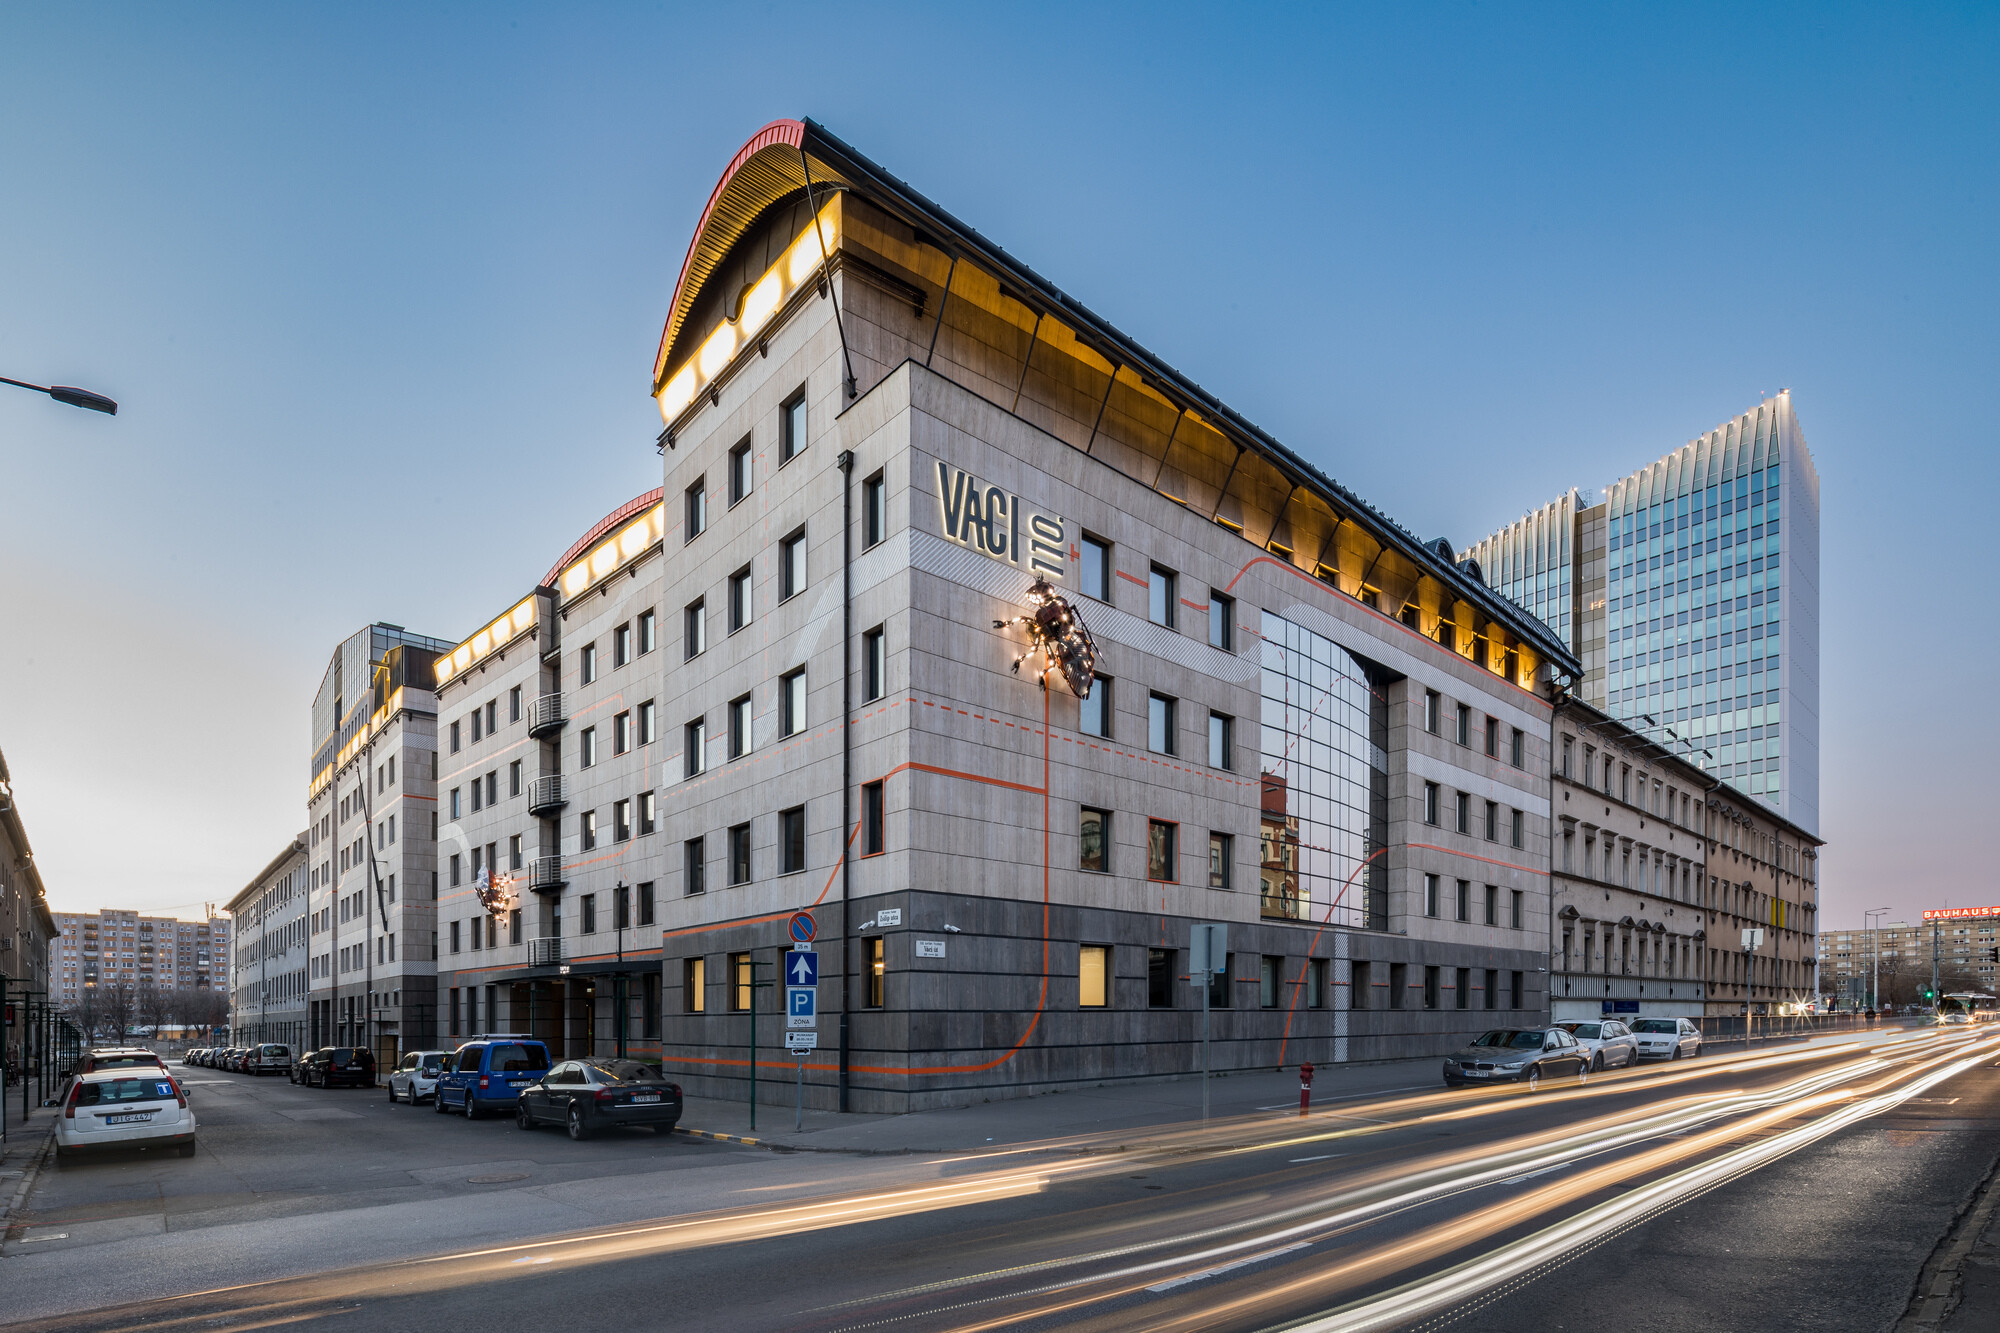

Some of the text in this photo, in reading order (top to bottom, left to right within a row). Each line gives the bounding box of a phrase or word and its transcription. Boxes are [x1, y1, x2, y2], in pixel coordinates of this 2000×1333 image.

[1923, 907, 1989, 918] BAUHAUS
[795, 993, 808, 1013] P
[158, 1084, 169, 1093] T
